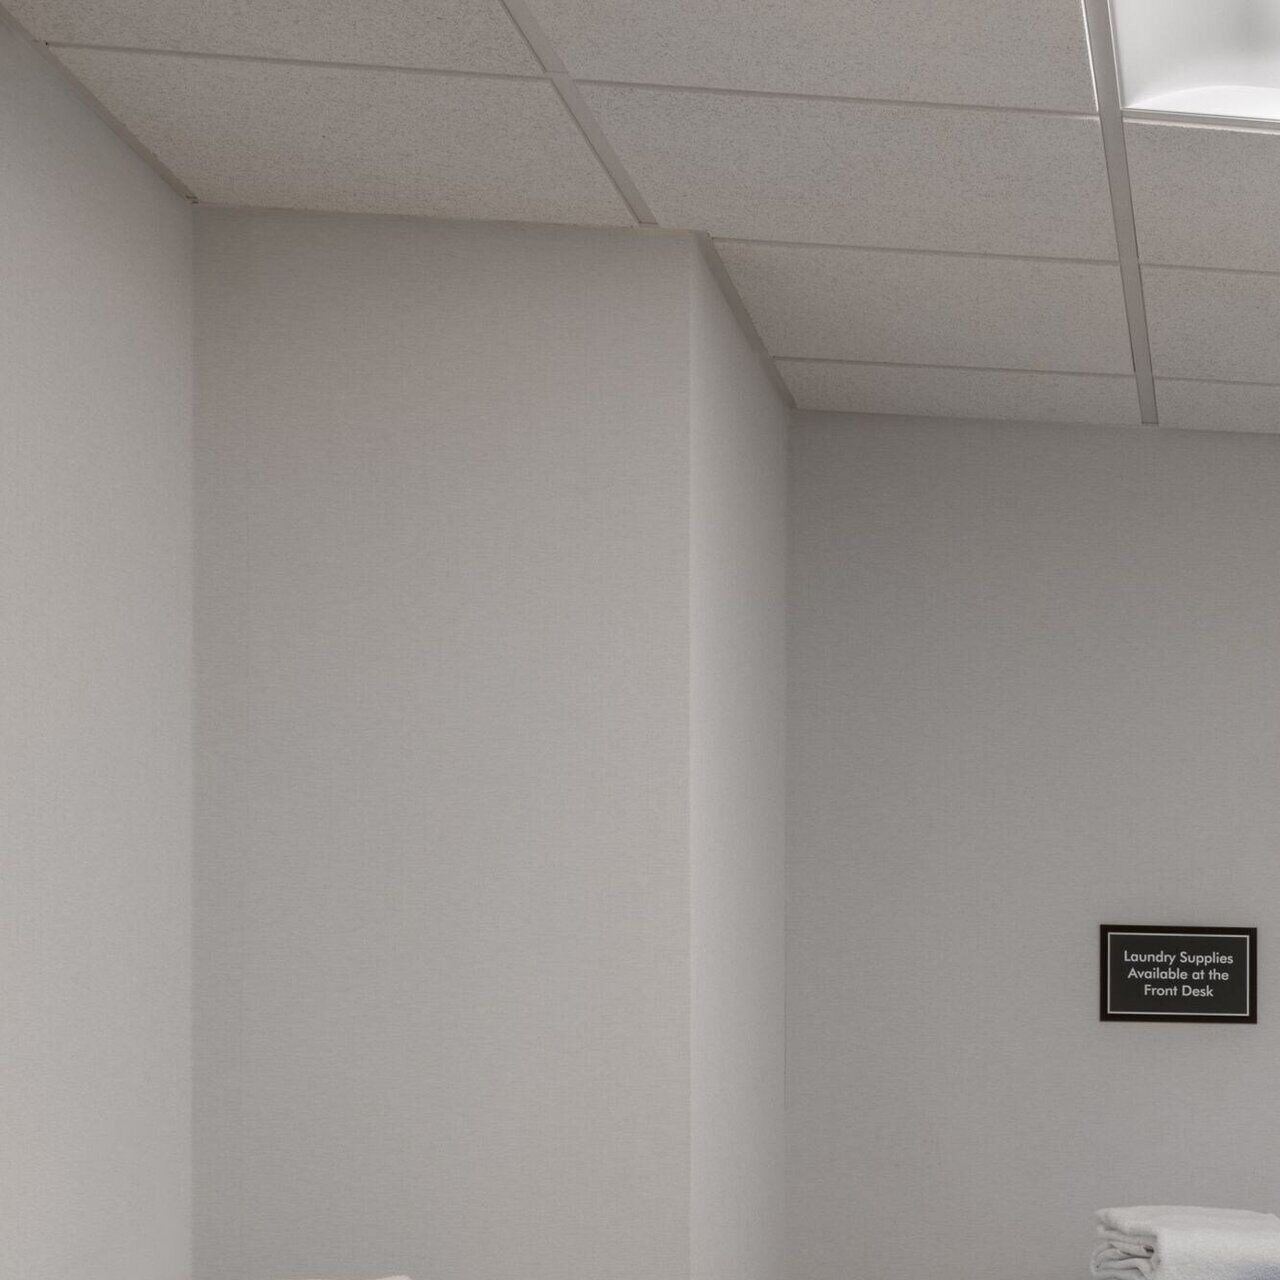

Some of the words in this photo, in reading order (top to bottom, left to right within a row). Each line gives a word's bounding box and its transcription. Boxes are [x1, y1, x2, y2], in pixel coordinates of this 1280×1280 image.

[1124, 950, 1176, 965] Laundry
[1179, 951, 1234, 966] Supplies
[1127, 967, 1188, 980] Available
[1192, 969, 1205, 980] at
[1208, 968, 1229, 980] the
[1144, 984, 1178, 996] Front
[1182, 985, 1214, 997] Desk
